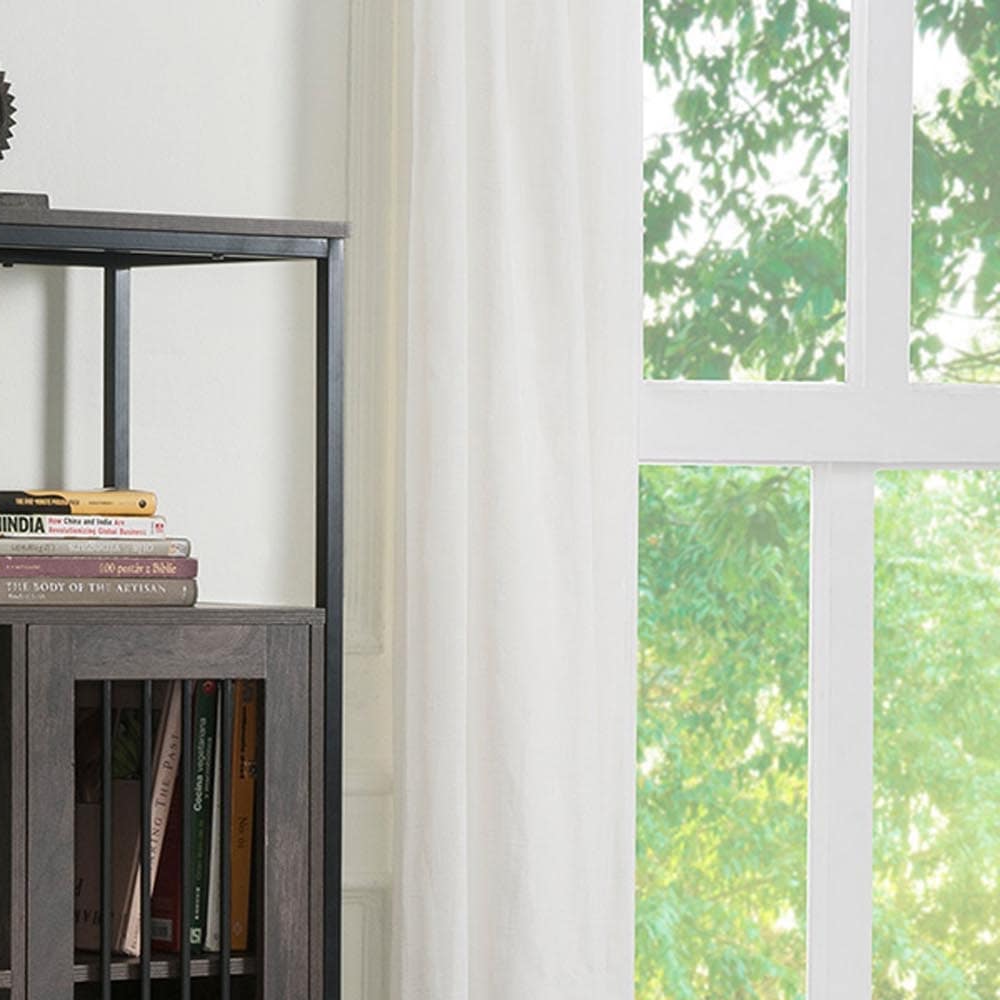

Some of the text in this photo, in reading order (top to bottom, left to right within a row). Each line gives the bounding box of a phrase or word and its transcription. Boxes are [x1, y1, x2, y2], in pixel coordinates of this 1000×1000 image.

[63, 517, 81, 526] China
[83, 518, 95, 526] and
[96, 518, 112, 526] India
[119, 528, 147, 536] Business
[7, 582, 167, 593] THE BODY OF THE ARTISAN
[193, 774, 203, 812] Cocina
[198, 717, 207, 773] vegetariana
